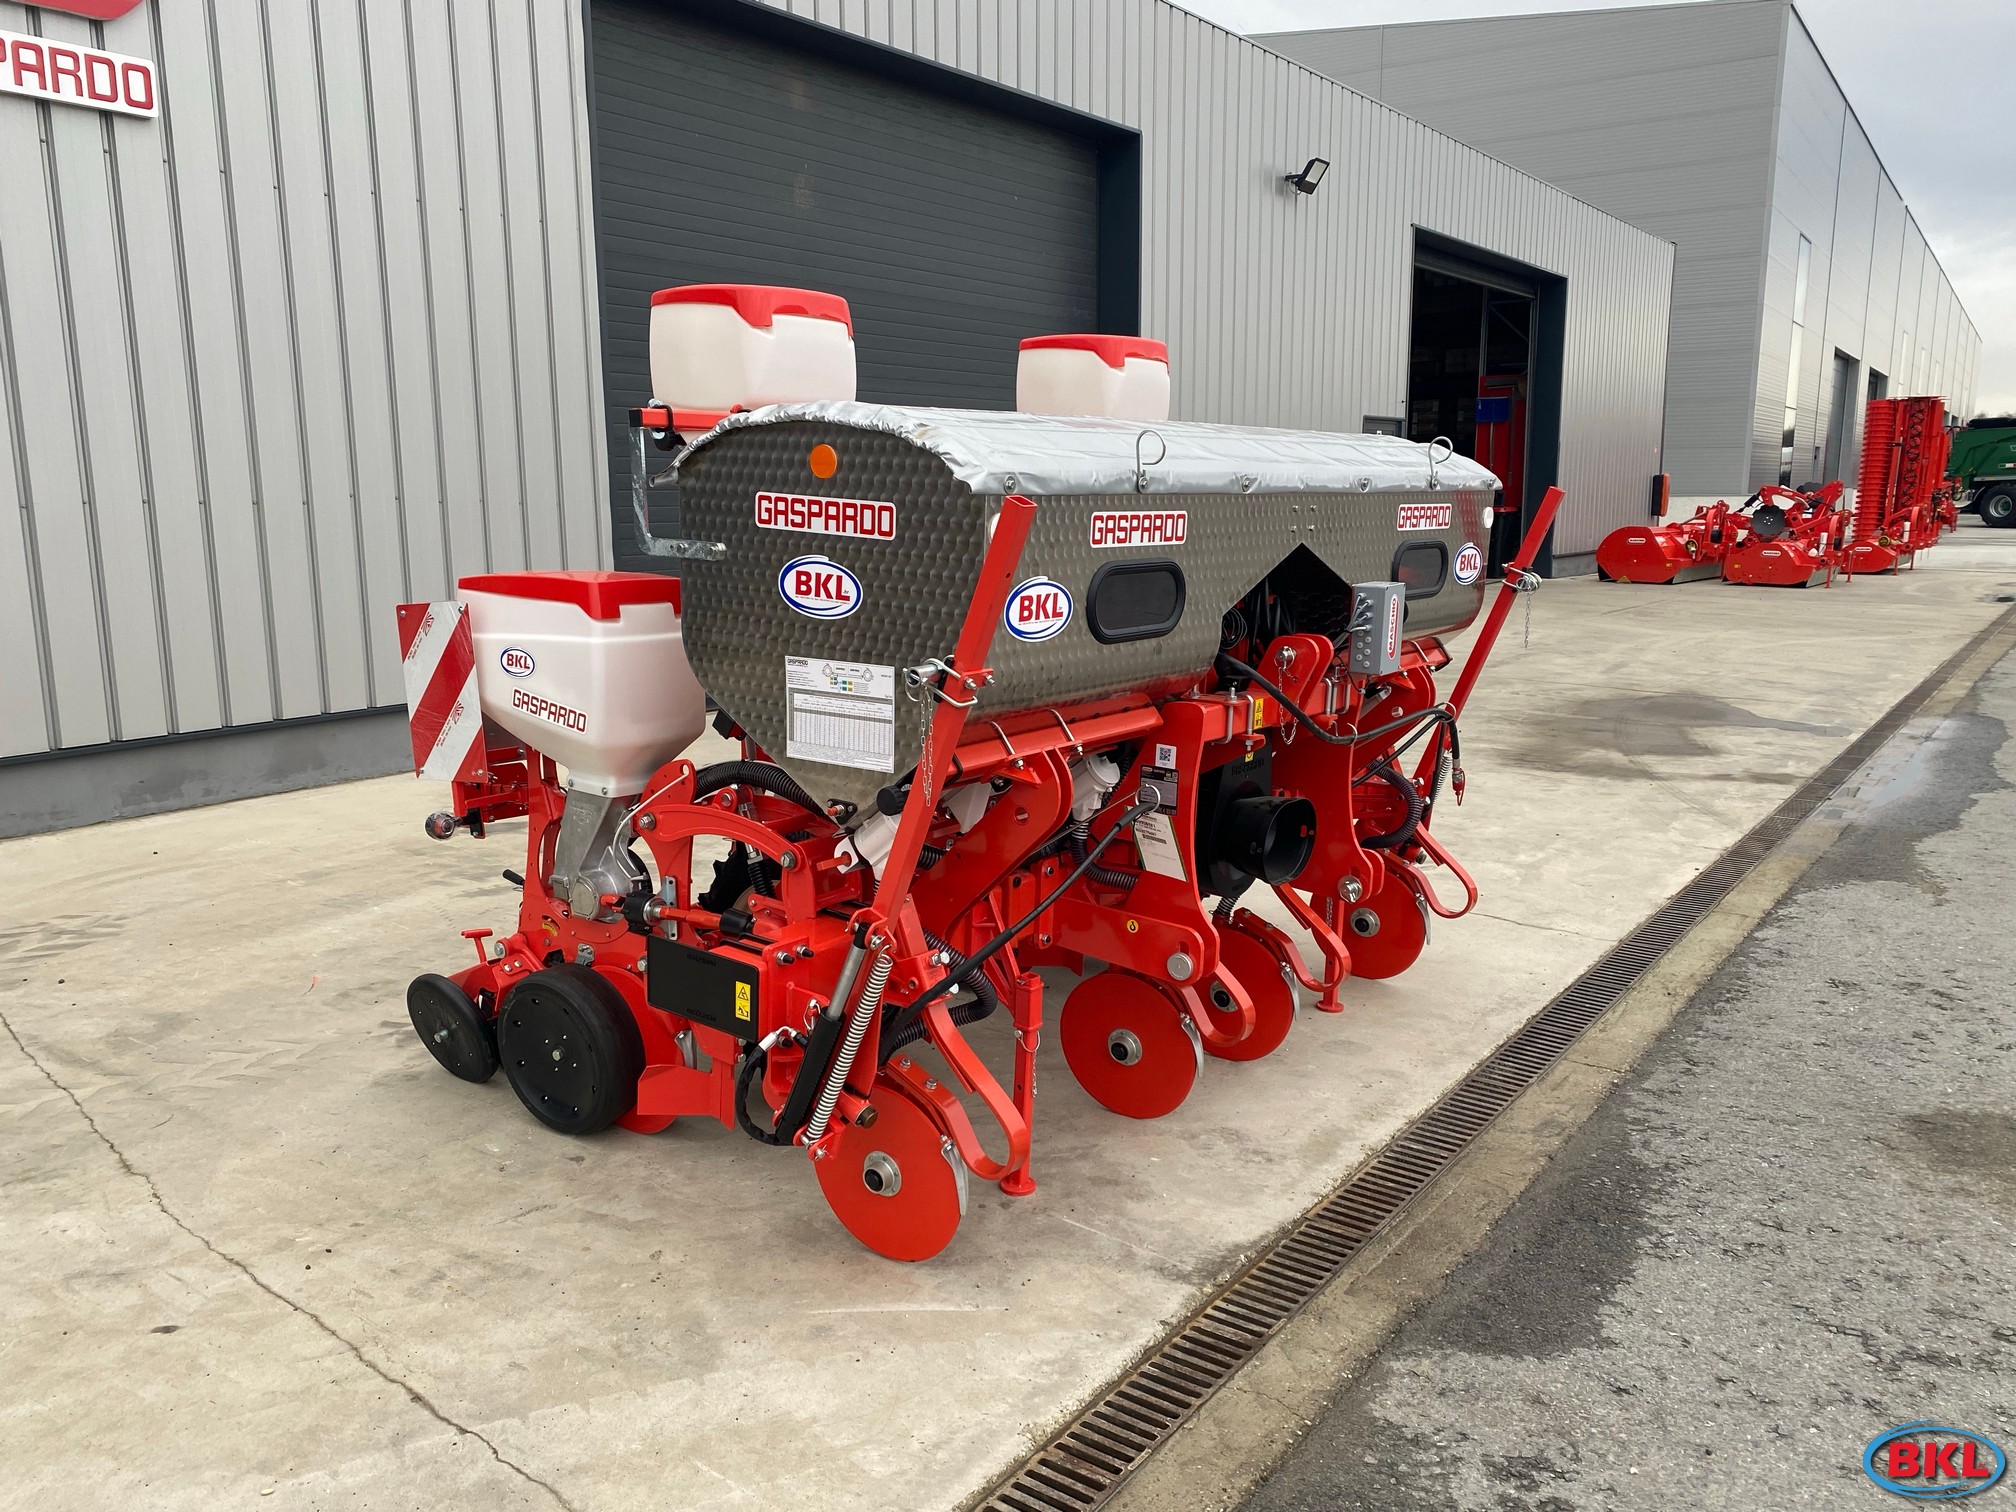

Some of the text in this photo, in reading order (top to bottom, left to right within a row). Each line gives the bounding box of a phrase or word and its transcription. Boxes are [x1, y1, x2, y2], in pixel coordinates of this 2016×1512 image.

[0, 38, 154, 110] ARDO
[757, 493, 895, 538] GASPARDO
[1092, 512, 1187, 545] GASPARDO
[1398, 505, 1451, 529] GASPARDO
[1459, 554, 1479, 572] BKL
[794, 569, 851, 602] BKL
[1018, 592, 1064, 623] BKL
[1388, 597, 1398, 651] MASCHIO
[506, 652, 531, 671] BKL
[512, 688, 588, 734] GASPARDO
